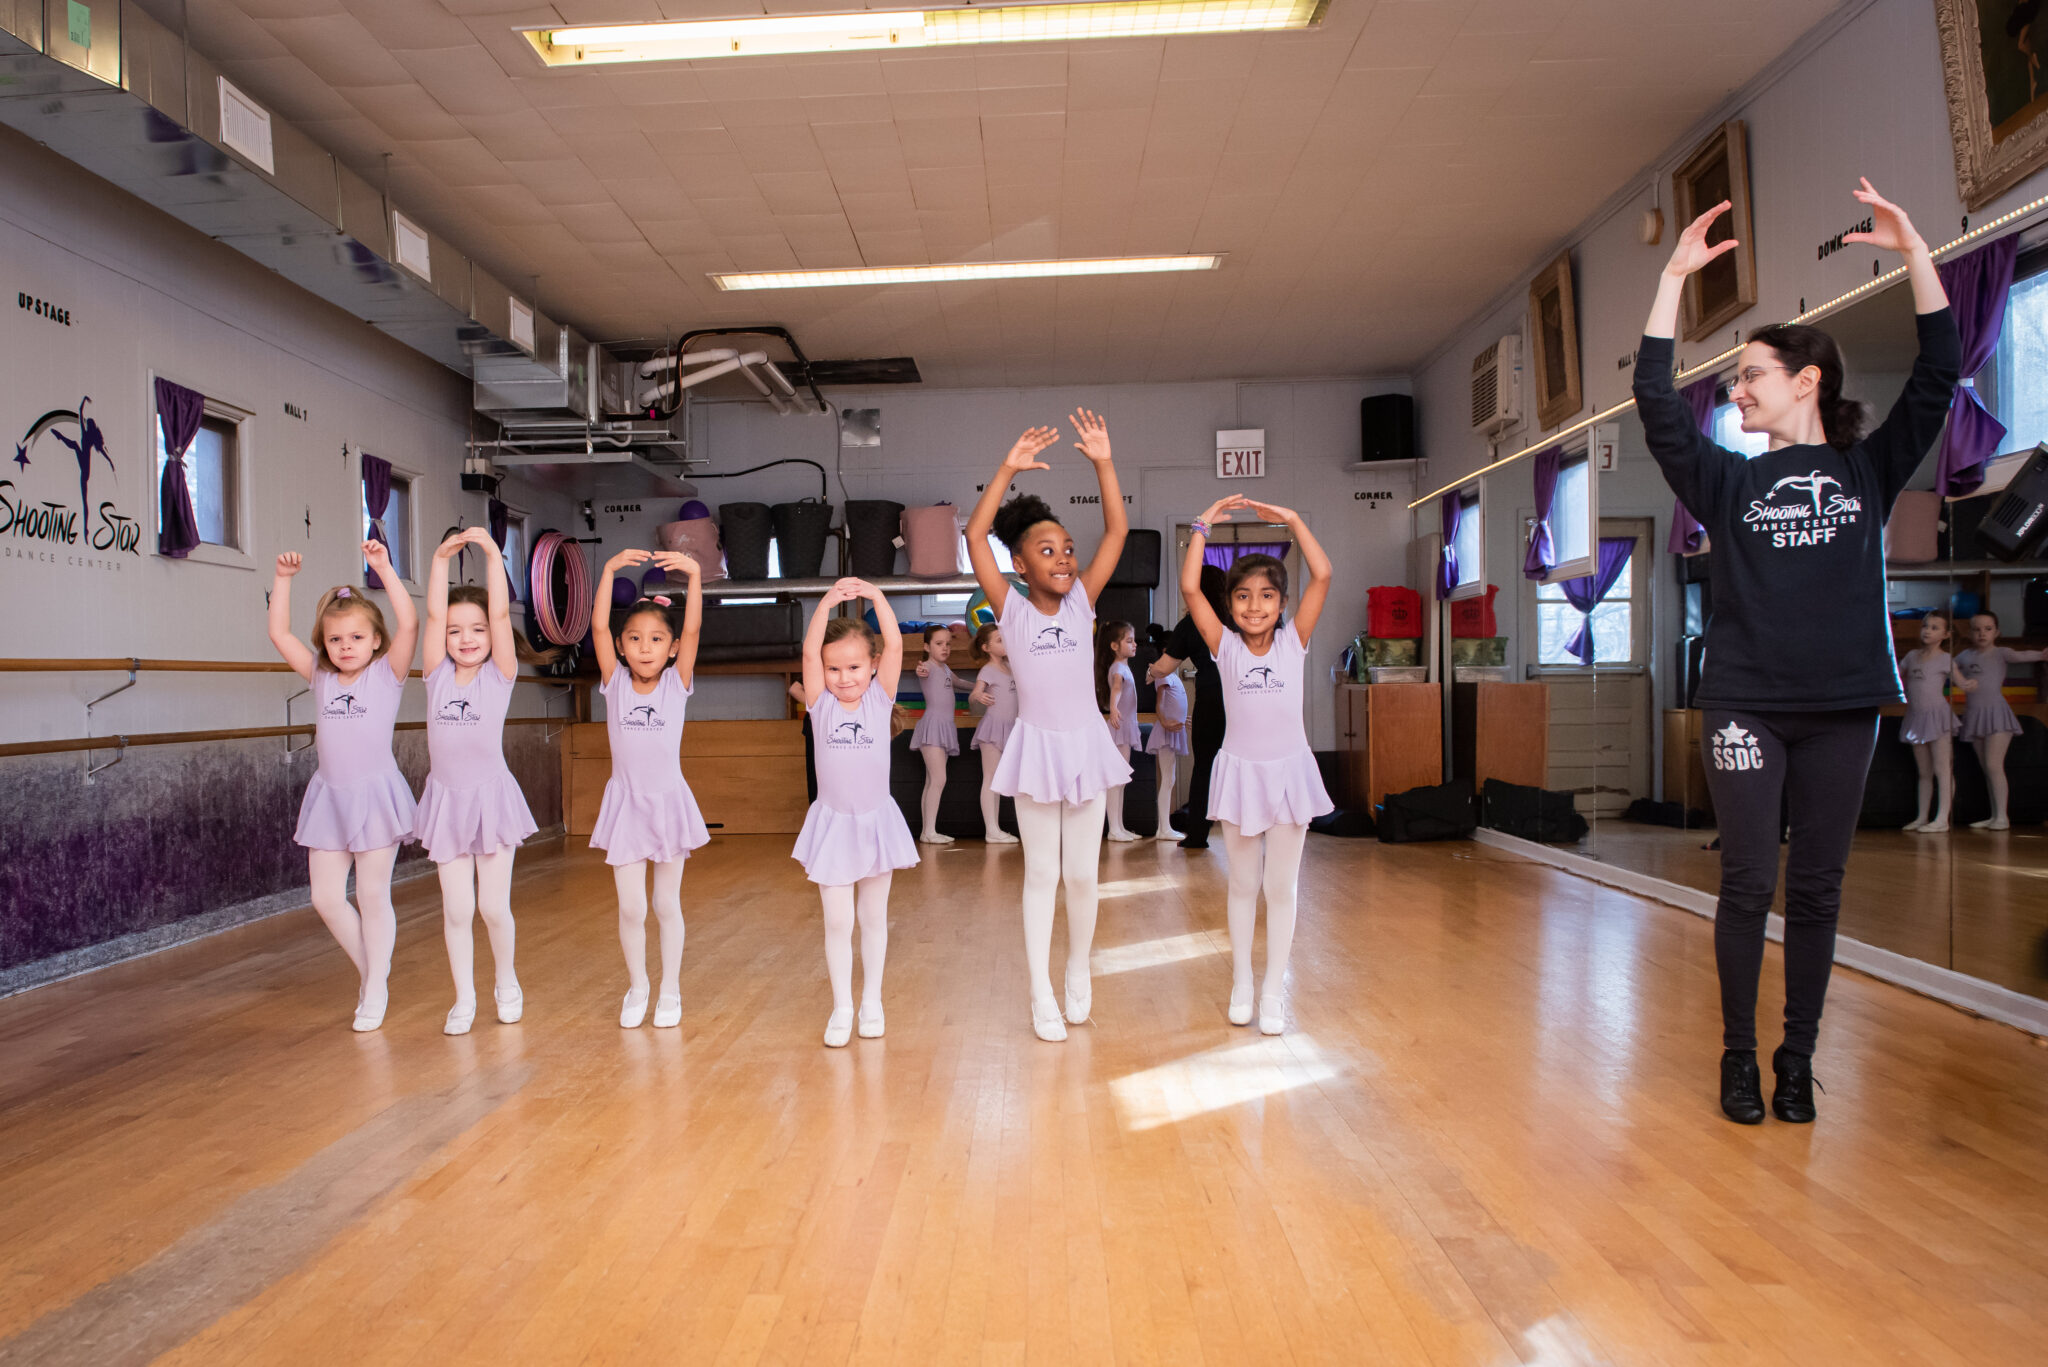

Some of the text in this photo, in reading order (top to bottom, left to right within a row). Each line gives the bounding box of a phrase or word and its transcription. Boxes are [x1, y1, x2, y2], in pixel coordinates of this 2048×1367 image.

[1961, 215, 1968, 235] 9
[18, 291, 71, 327] UPSTAGE
[284, 402, 302, 420] WALL
[1222, 450, 1262, 477] EXIT
[1069, 495, 1100, 505] STAGE
[1354, 491, 1393, 501] CORNER
[1370, 501, 1376, 510] 2
[604, 503, 642, 513] CORNER
[1752, 514, 1857, 532] DANCE CENTER
[1772, 527, 1837, 549] STAFF
[5, 547, 121, 571] DANCE CENTER
[1712, 746, 1764, 771] SSDC
